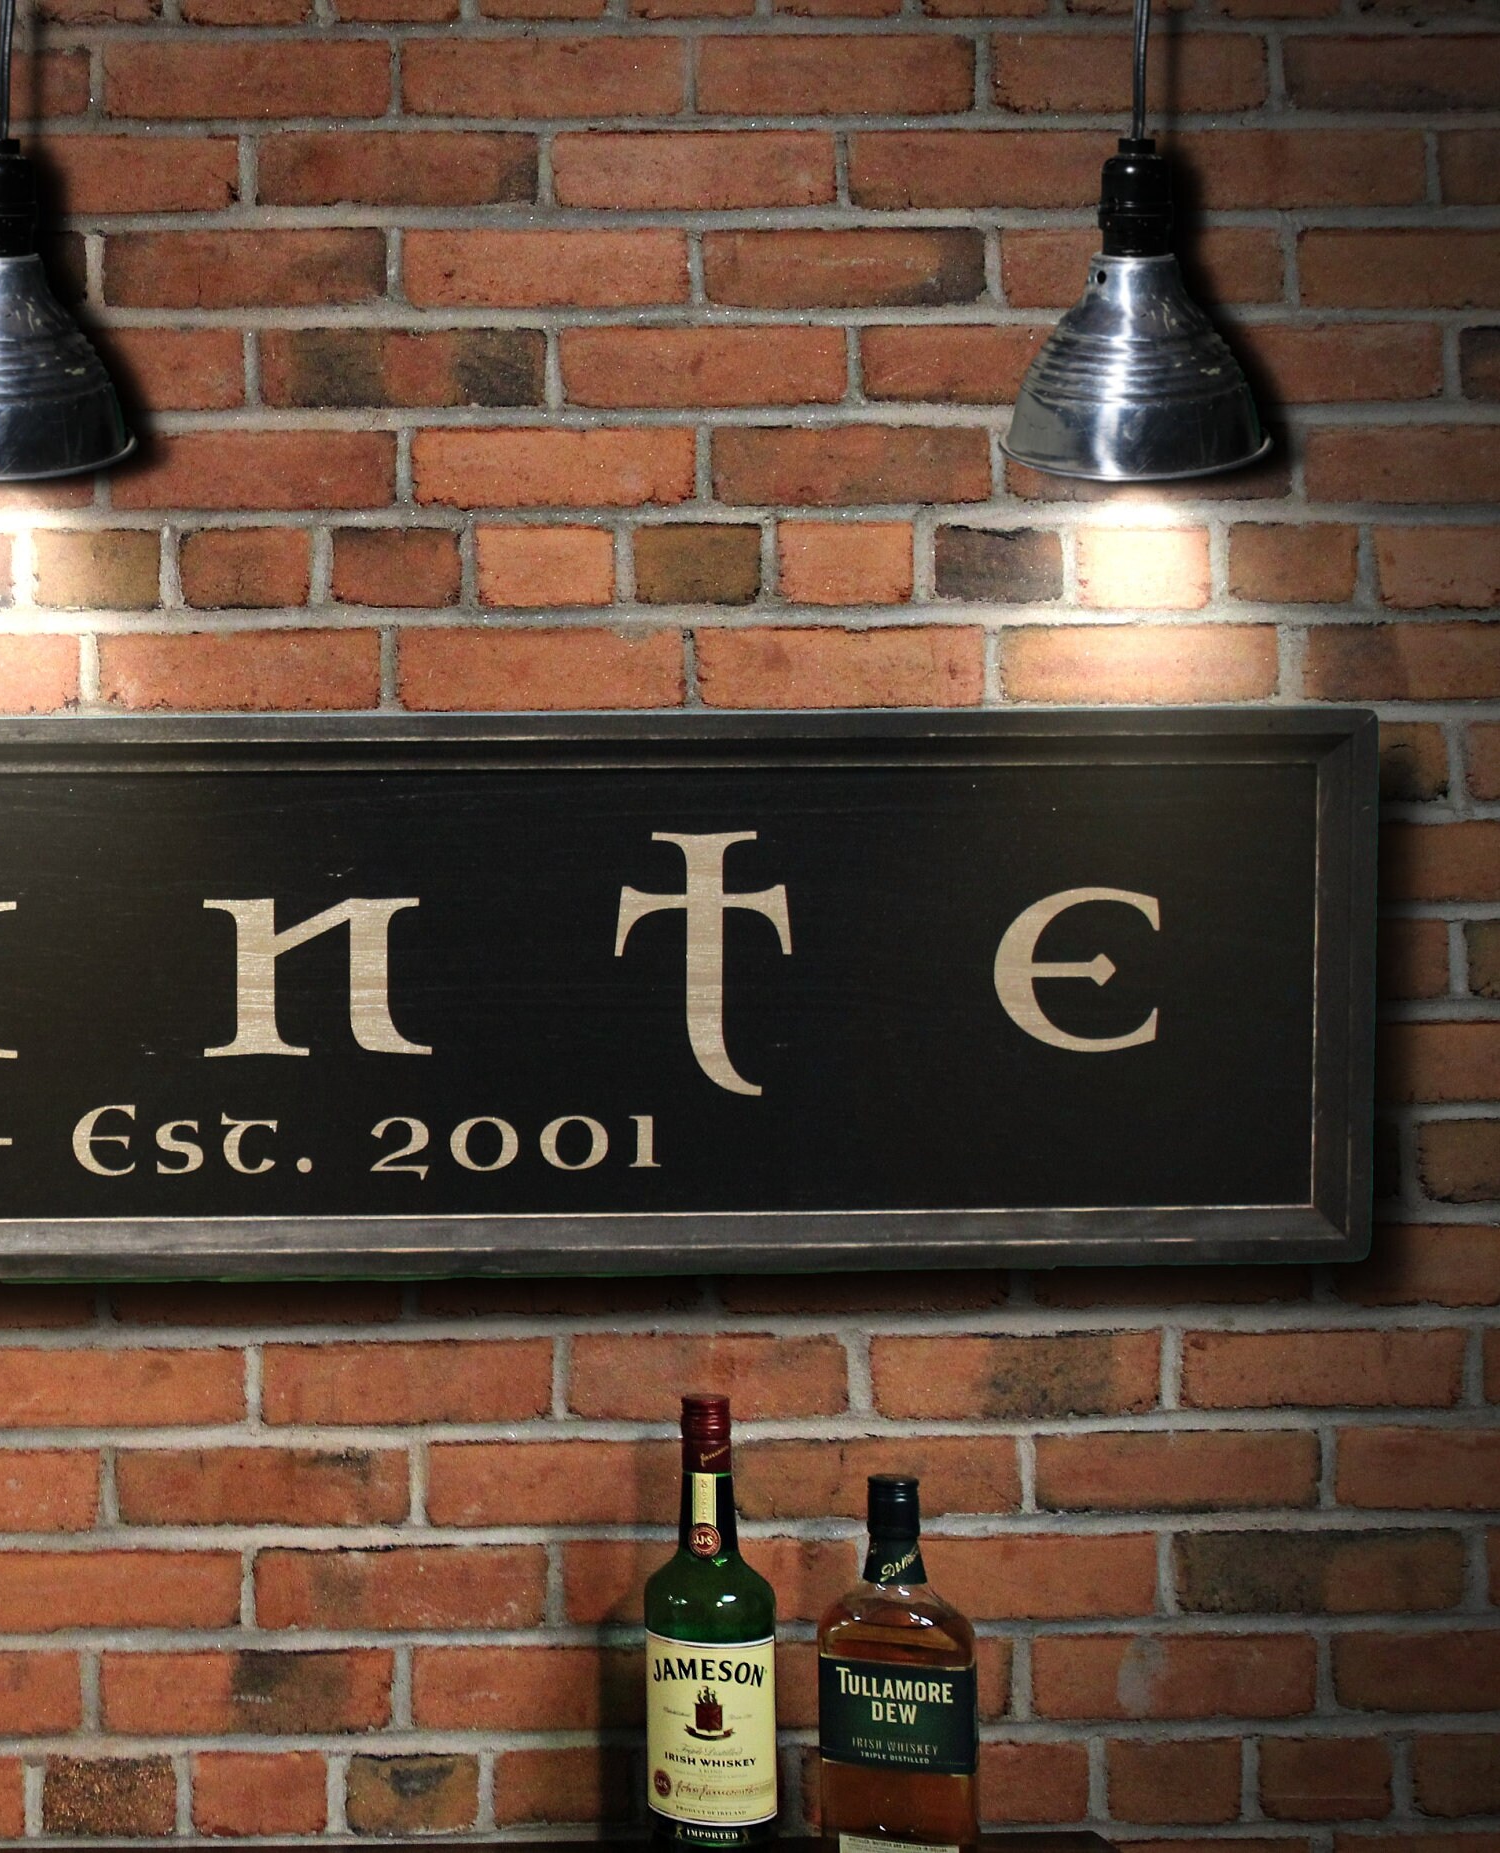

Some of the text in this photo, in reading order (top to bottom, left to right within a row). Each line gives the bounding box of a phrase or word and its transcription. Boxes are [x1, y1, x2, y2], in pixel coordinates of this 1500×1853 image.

[71, 1104, 313, 1177] Est.
[370, 1115, 662, 1181] 2001
[653, 1658, 765, 1688] JAMESON
[871, 1701, 917, 1725] DEW
[852, 1736, 938, 1755] IRISH WHISKEY
[664, 1751, 757, 1768] IRISH WHISKEY
[861, 1751, 930, 1765] TRIPLE DISTILLED
[686, 1828, 739, 1840] IMPORTED
